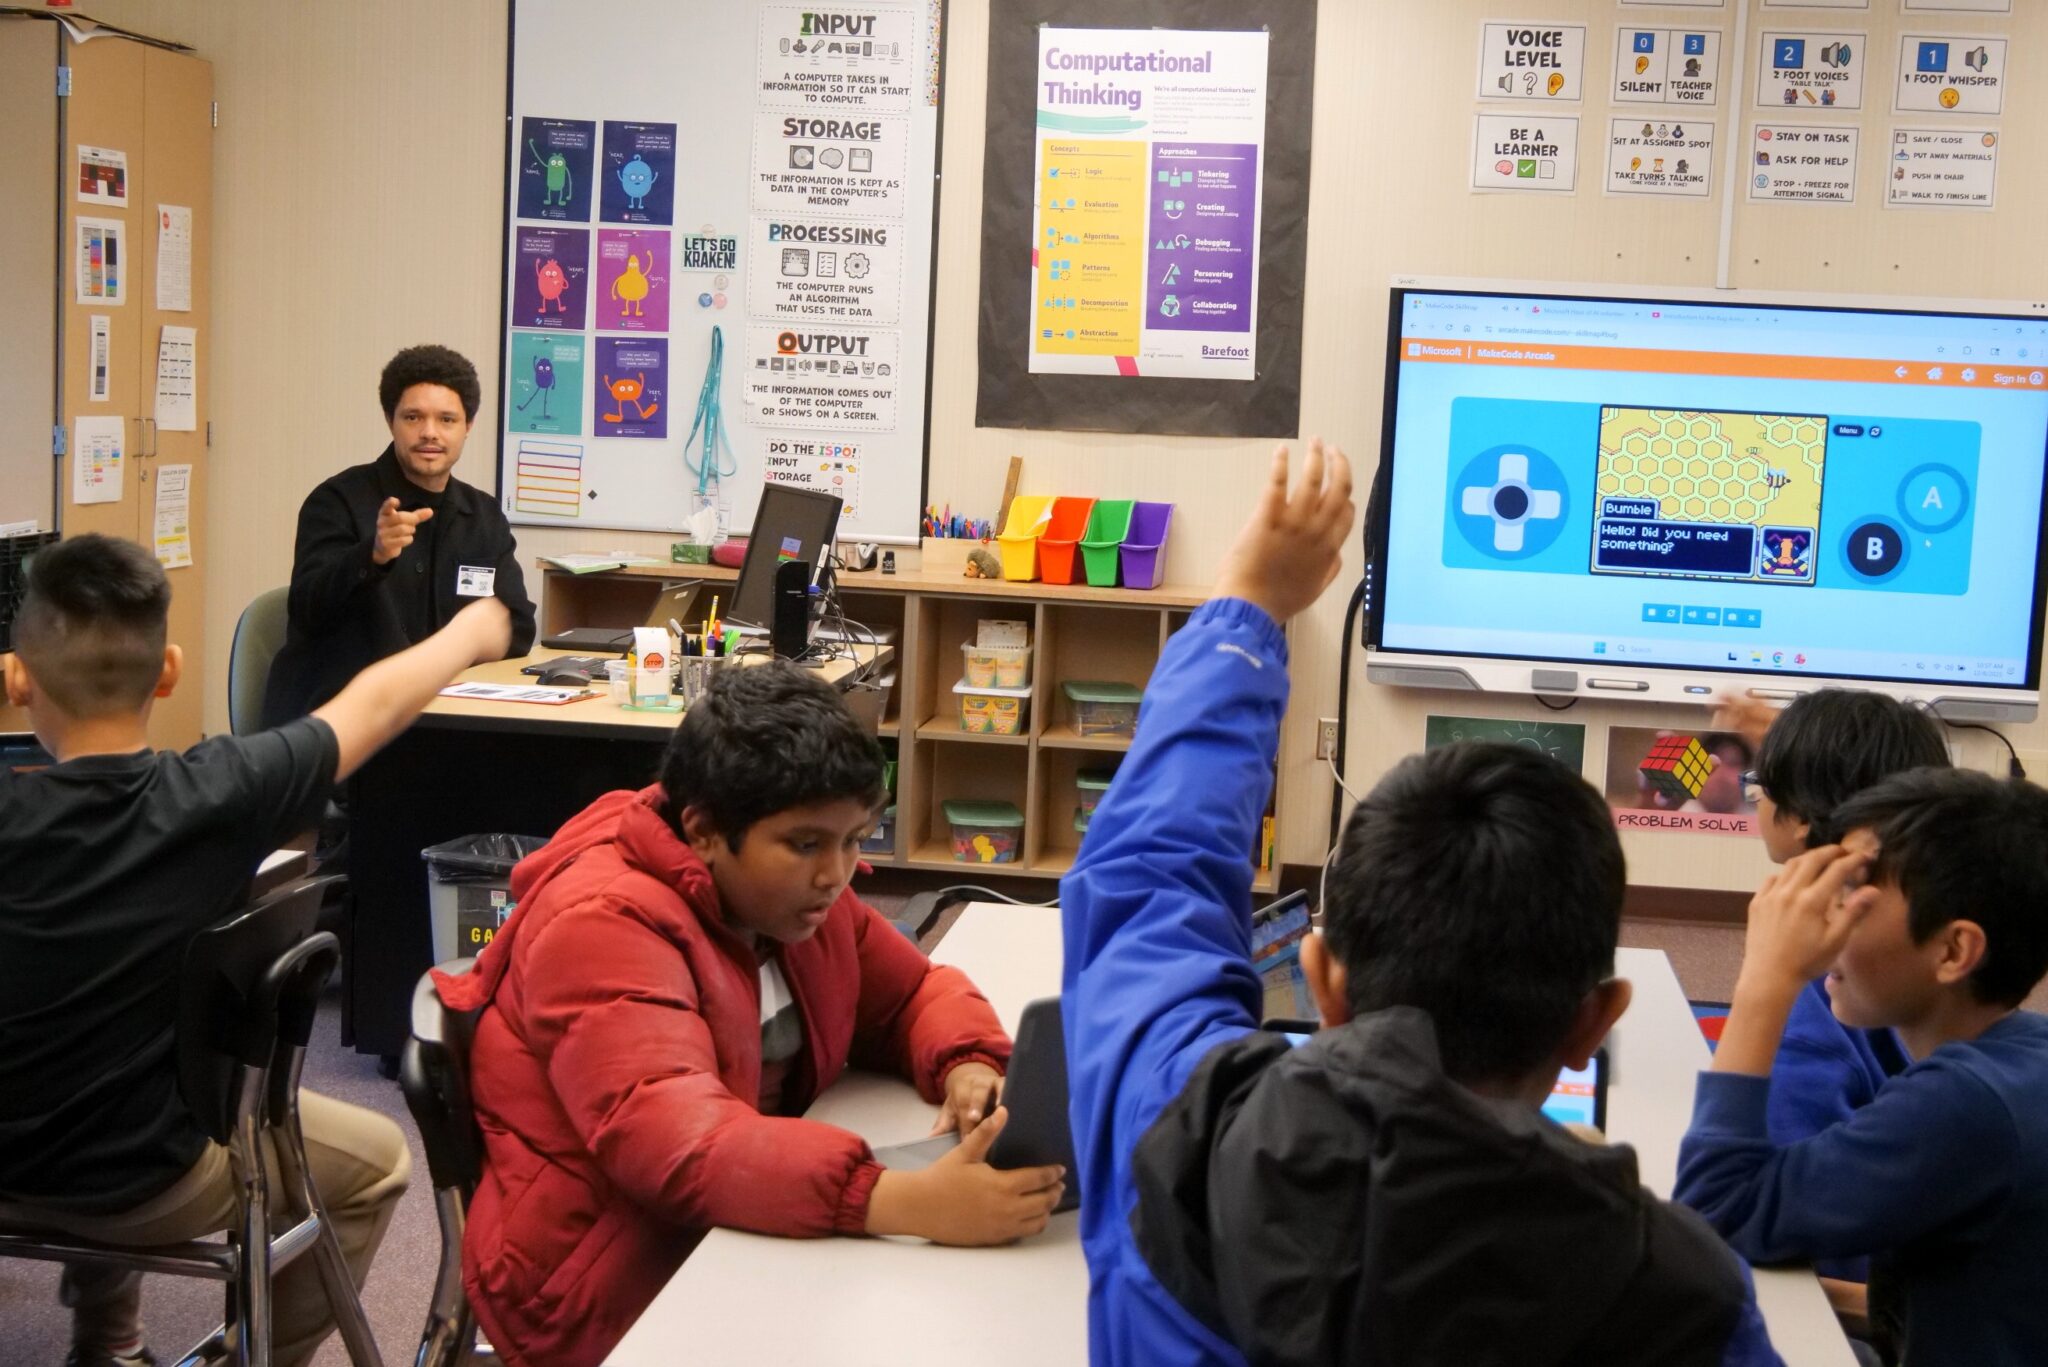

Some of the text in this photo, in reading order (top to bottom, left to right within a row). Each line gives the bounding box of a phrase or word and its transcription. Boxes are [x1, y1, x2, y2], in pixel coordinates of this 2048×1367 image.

[802, 13, 876, 35] INPUT
[1507, 30, 1562, 47] VOICE
[1640, 37, 1648, 48] 0
[1691, 39, 1698, 50] 3
[1505, 51, 1561, 67] LEVEL
[1784, 46, 1793, 61] 2
[1929, 50, 1936, 64] 1
[1045, 48, 1212, 75] Computational
[795, 74, 842, 82] COMPUTER
[847, 75, 875, 83] TAKES
[880, 76, 888, 84] IN
[1774, 71, 1849, 81] 2 FOOT VOICES
[1905, 74, 1997, 86] 1 FOOT WHISPER
[763, 83, 825, 92] INFORMATION
[830, 85, 843, 93] SO
[859, 86, 876, 94] CAN
[881, 87, 909, 95] START
[1620, 81, 1661, 93] SILENT
[1671, 81, 1712, 90] TEACHER
[821, 95, 866, 104] COMPUTE.
[1044, 82, 1141, 110] Thinking
[1677, 91, 1704, 100] VOICE
[783, 118, 881, 140] STORAGE
[1510, 129, 1544, 141] BE A
[1614, 137, 1710, 149] SIT AT ASSIGNED SPOT
[1776, 132, 1849, 143] STAY ON TASK
[1159, 148, 1197, 156] Approaches
[1495, 143, 1558, 156] LEARNER
[1776, 156, 1848, 166] ASK FOR HELP
[1198, 170, 1229, 178] Tinkering
[761, 174, 777, 182] THE
[781, 175, 843, 185] INFORMATION
[861, 179, 882, 187] KEPT
[886, 180, 899, 188] AS
[1774, 180, 1795, 188] STOP
[1805, 181, 1830, 189] FREEZE
[771, 185, 794, 193] DATA
[811, 187, 826, 195] THE
[831, 188, 887, 197] COMPUTER'S
[808, 197, 849, 205] MEMORY
[1197, 203, 1225, 211] Creating
[770, 224, 886, 244] PROCESSING
[1084, 233, 1119, 241] Algorithms
[685, 238, 735, 251] LET'S GO
[1195, 239, 1230, 247] Debugging
[684, 251, 735, 269] KRAKEN!
[1194, 270, 1233, 278] Persevering
[777, 282, 873, 294] THE COMPUTER RUNS
[806, 295, 859, 304] ALGORITHM
[1081, 299, 1128, 307] Decomposition
[1193, 301, 1237, 309] Collaborating
[776, 305, 872, 316] THAT USES THE DATA
[778, 332, 869, 354] OUTPUT
[1202, 345, 1249, 356] Barefoot
[1422, 346, 1462, 356] Microsoft
[1477, 349, 1555, 360] MakeCode Arcade
[1993, 373, 2026, 385] Sign In
[752, 385, 891, 399] THE INFORMATION COMES OUT
[815, 399, 862, 408] COMPUTER
[779, 409, 812, 417] SHOWS
[817, 410, 829, 418] ON
[844, 412, 879, 421] SCREEN.
[1839, 426, 1858, 435] Menu
[770, 443, 856, 457] DO THE ISPO!
[768, 457, 798, 466] INPUT
[767, 471, 811, 482] STORAGE
[1922, 487, 1942, 509] A
[1606, 503, 1652, 516] Bumble
[1602, 525, 1728, 542] Hello! Did you need
[1601, 539, 1675, 555] something?
[1866, 537, 1883, 560] B
[1619, 815, 1748, 832] PROBLEM SOLVE
